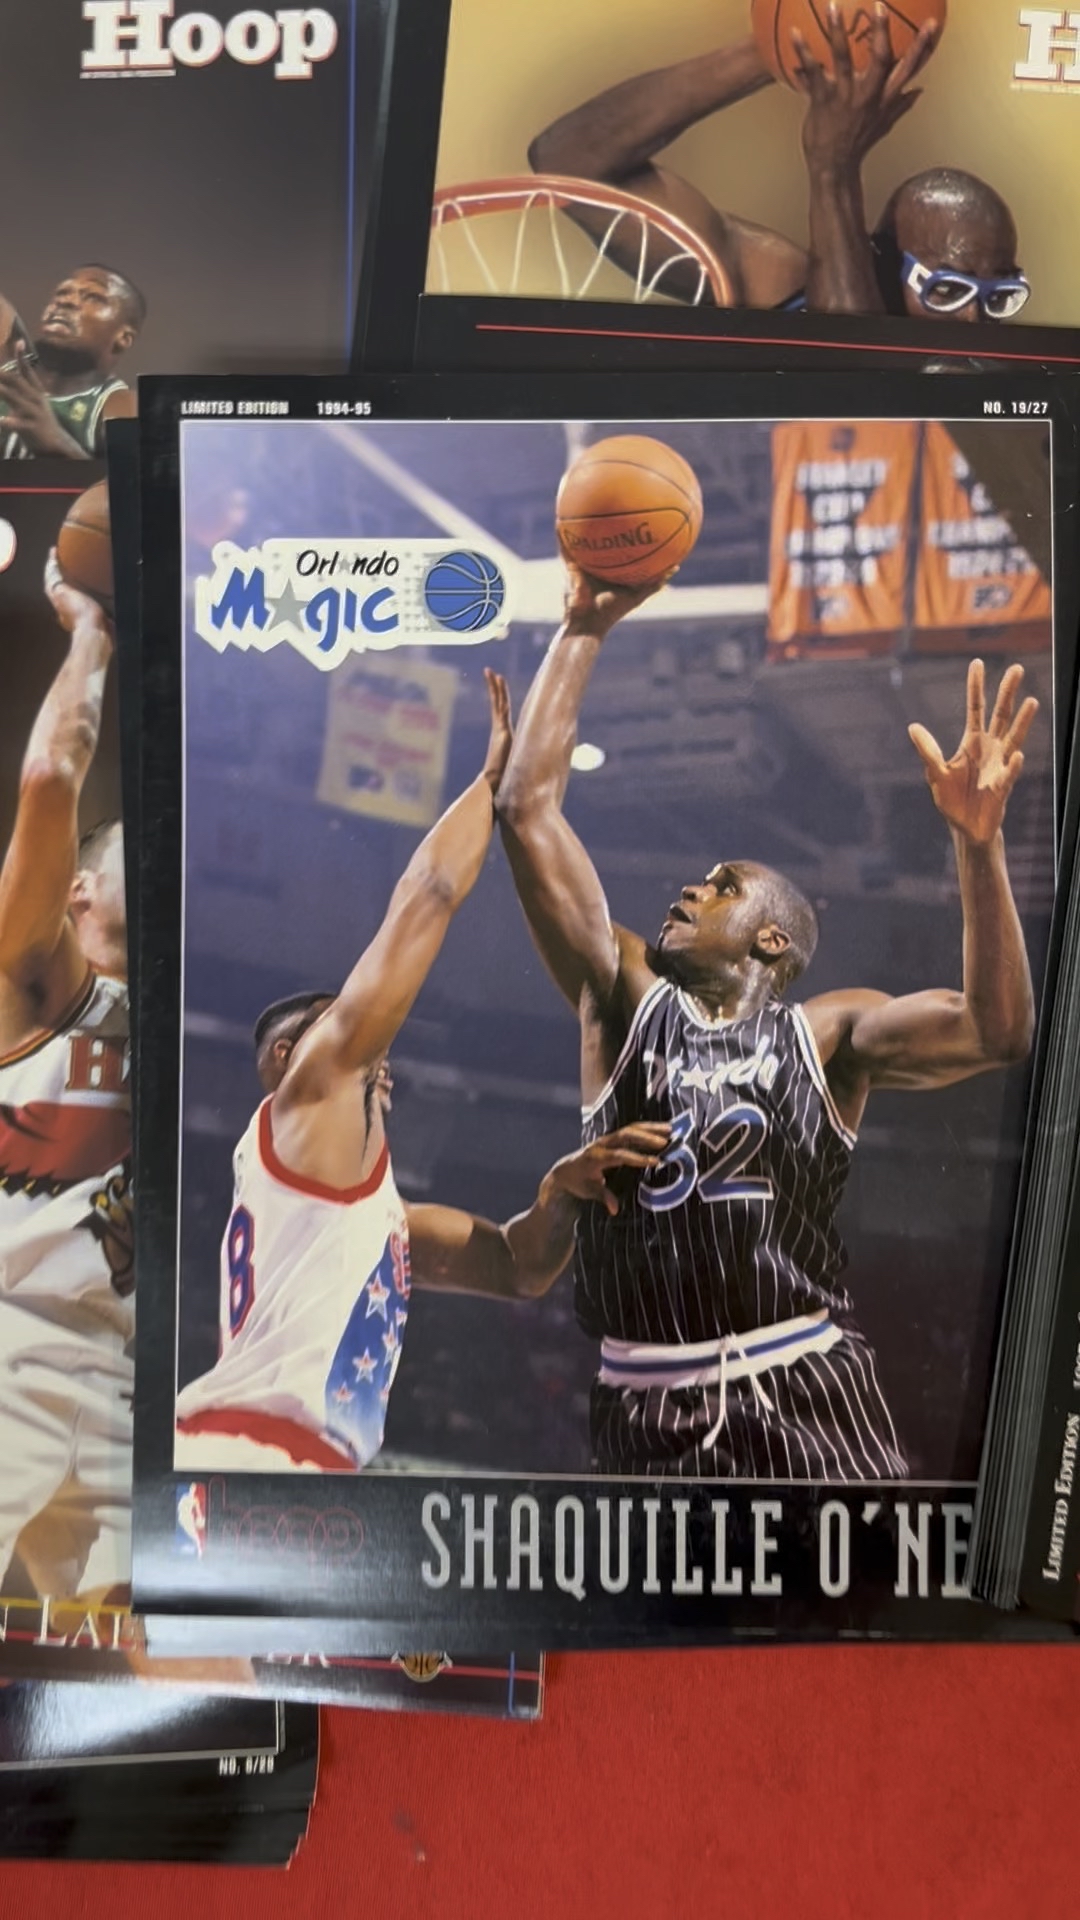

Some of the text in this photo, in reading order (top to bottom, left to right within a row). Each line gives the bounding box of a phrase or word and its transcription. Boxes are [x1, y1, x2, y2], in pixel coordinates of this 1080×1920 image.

[82, 0, 338, 80] Hoop
[181, 400, 289, 415] LIMITED EDITION
[317, 402, 371, 415] 1994-95
[983, 401, 1048, 414] NO. 19/27
[637, 1103, 774, 1212] 32
[421, 1491, 972, 1601] SHAQUILLE O'NE
